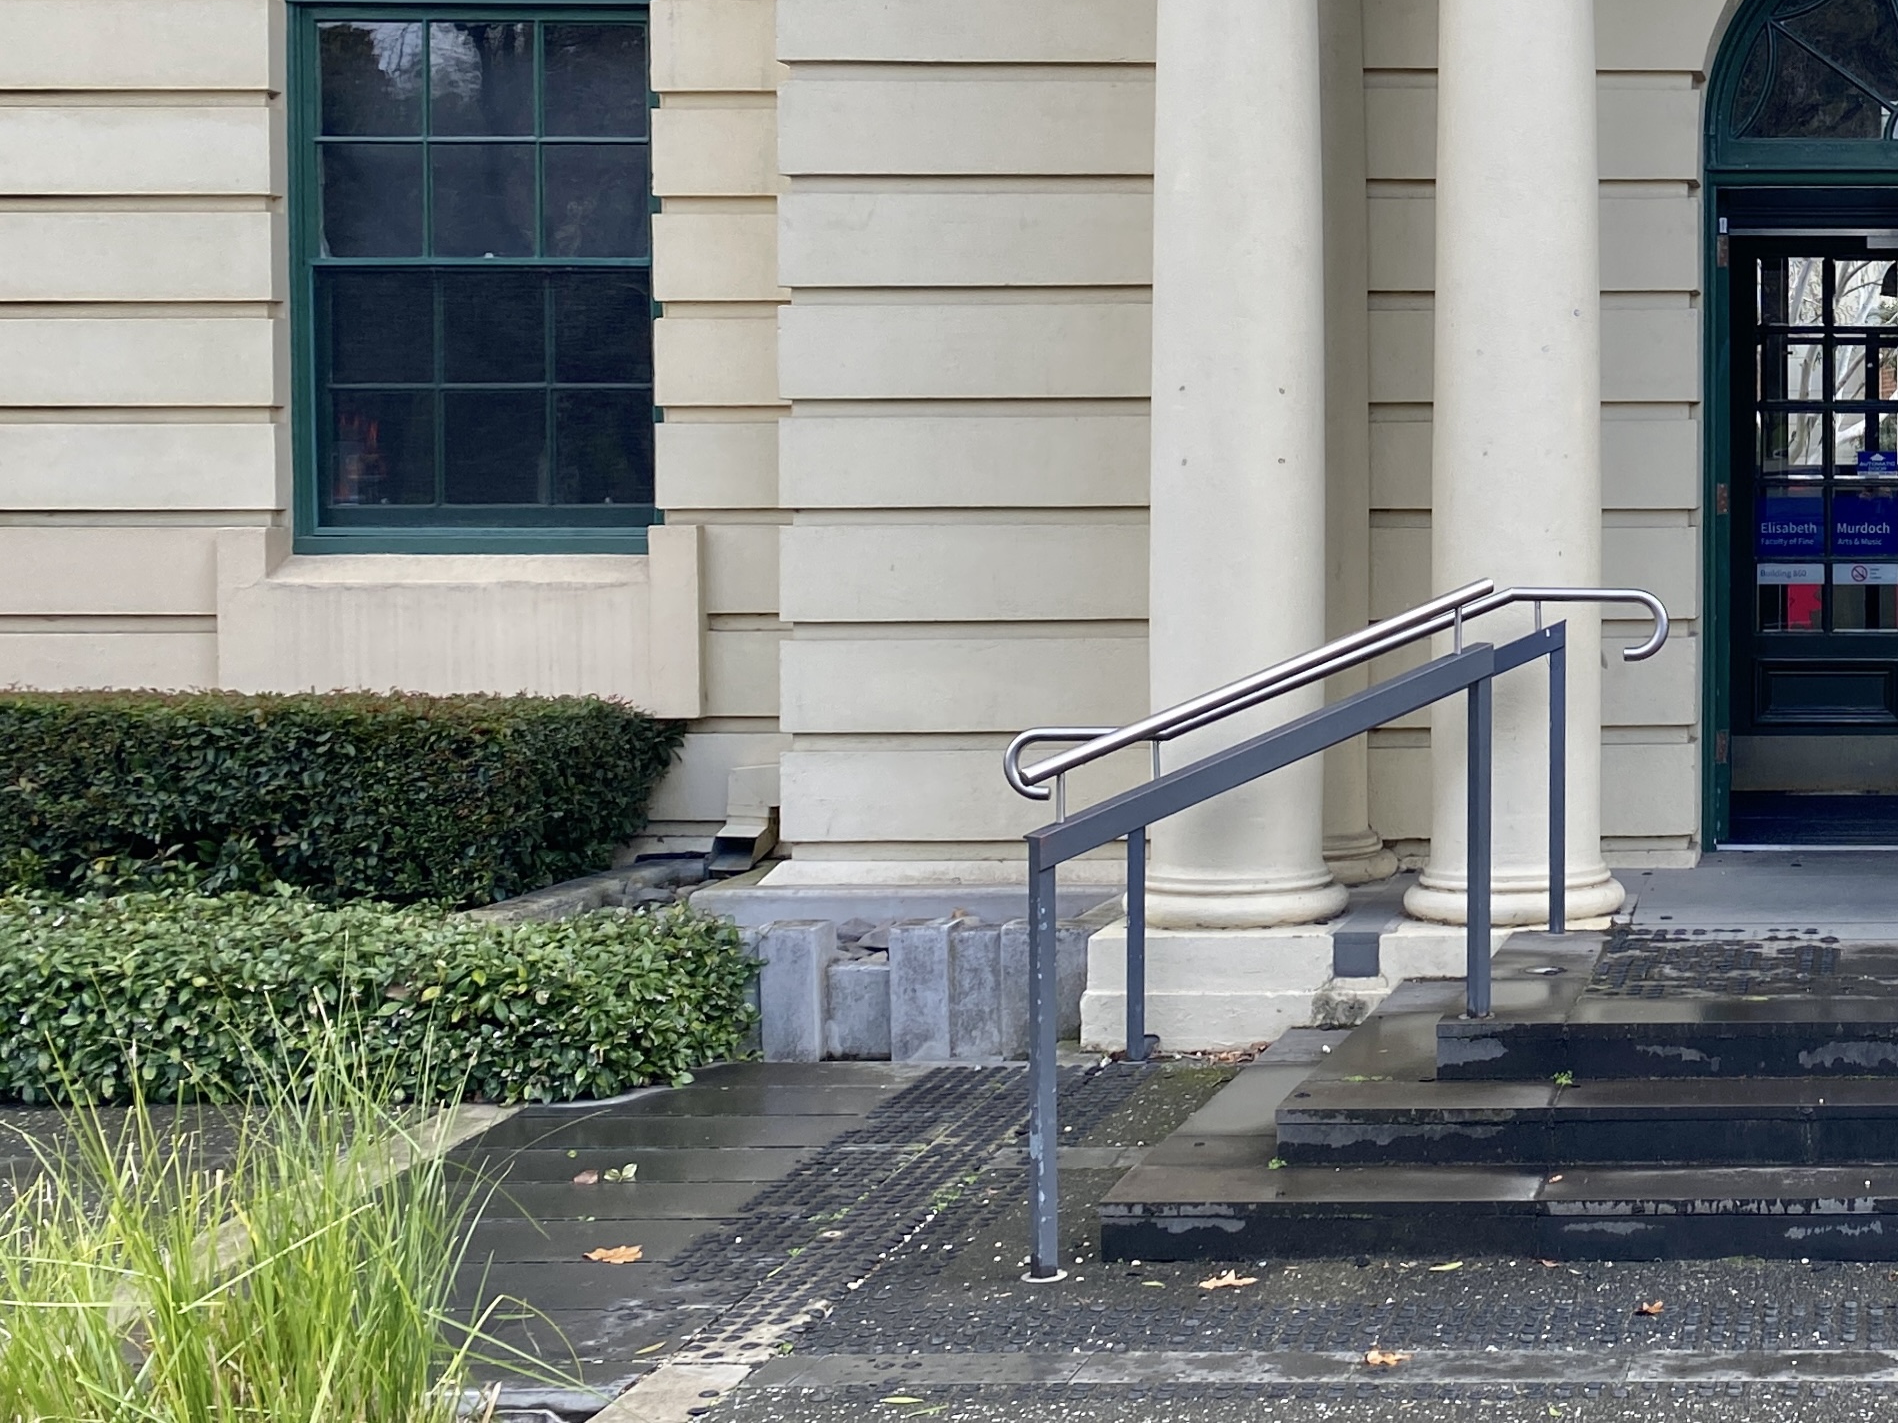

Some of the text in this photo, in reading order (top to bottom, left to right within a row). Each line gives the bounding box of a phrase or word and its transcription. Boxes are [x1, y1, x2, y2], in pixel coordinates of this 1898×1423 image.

[1760, 522, 1818, 534] Elisabeth
[1836, 522, 1891, 534] Murdoch
[1760, 538, 1787, 547] Faculty
[1760, 569, 1792, 579] Building
